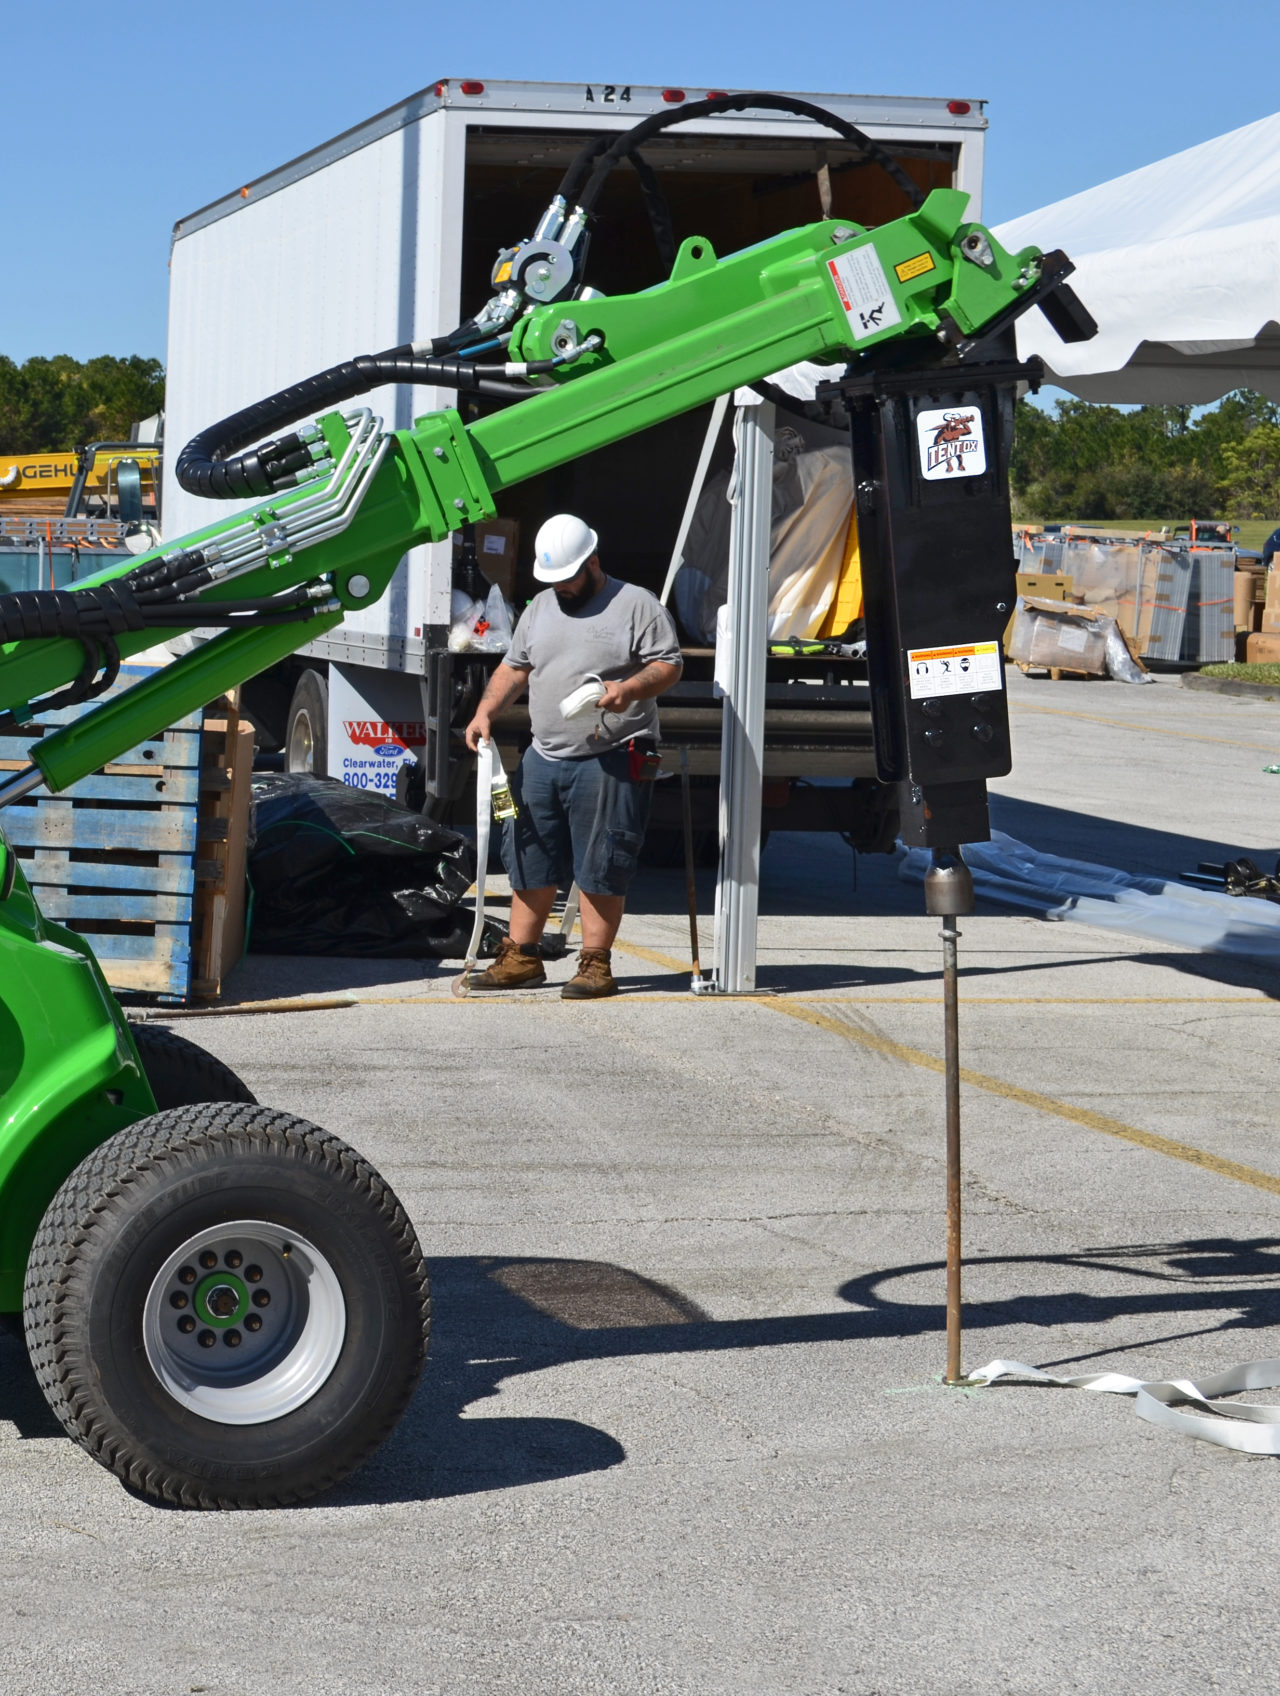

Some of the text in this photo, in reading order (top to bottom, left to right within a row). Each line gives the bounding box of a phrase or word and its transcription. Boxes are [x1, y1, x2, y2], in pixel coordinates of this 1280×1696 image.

[928, 440, 977, 468] TENT OX
[343, 721, 426, 738] WALKER
[379, 746, 399, 756] Ford
[343, 758, 399, 771] Clearwater,
